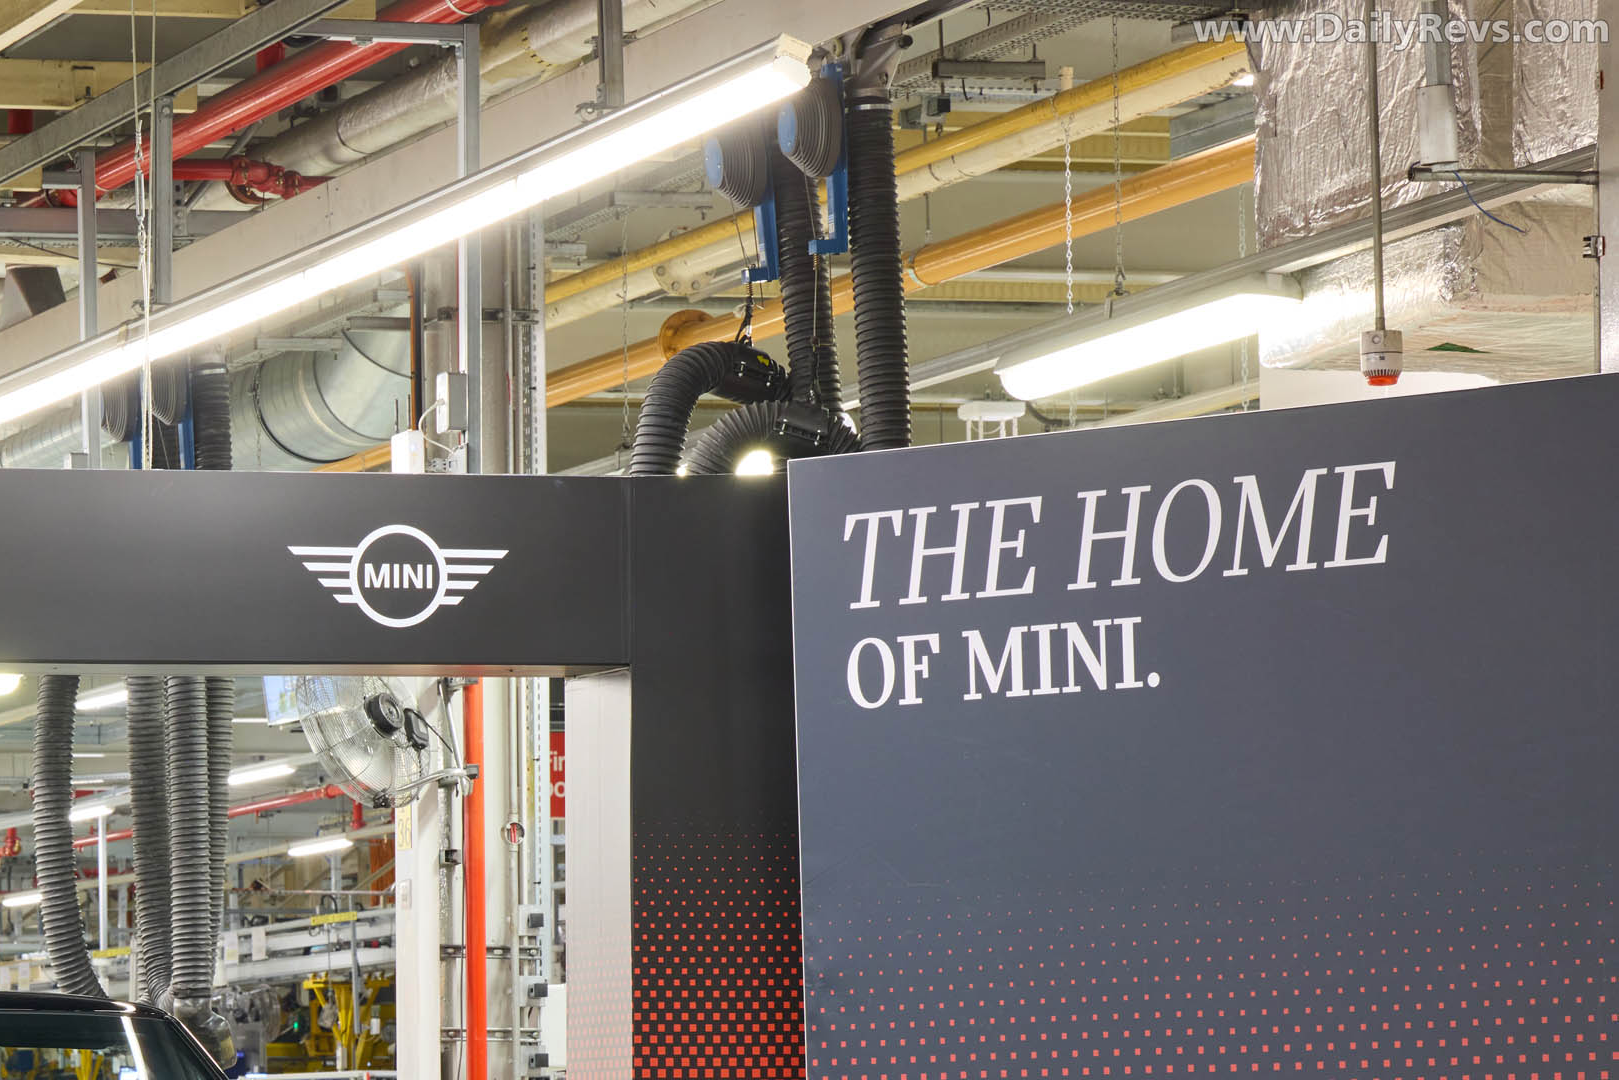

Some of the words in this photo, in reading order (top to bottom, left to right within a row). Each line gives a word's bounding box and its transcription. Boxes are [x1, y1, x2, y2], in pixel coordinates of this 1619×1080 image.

[364, 563, 433, 589] MINI
[843, 495, 1043, 610] THE
[1066, 460, 1397, 591] HOME
[846, 632, 941, 710] OF
[961, 616, 1161, 701] MINI.
